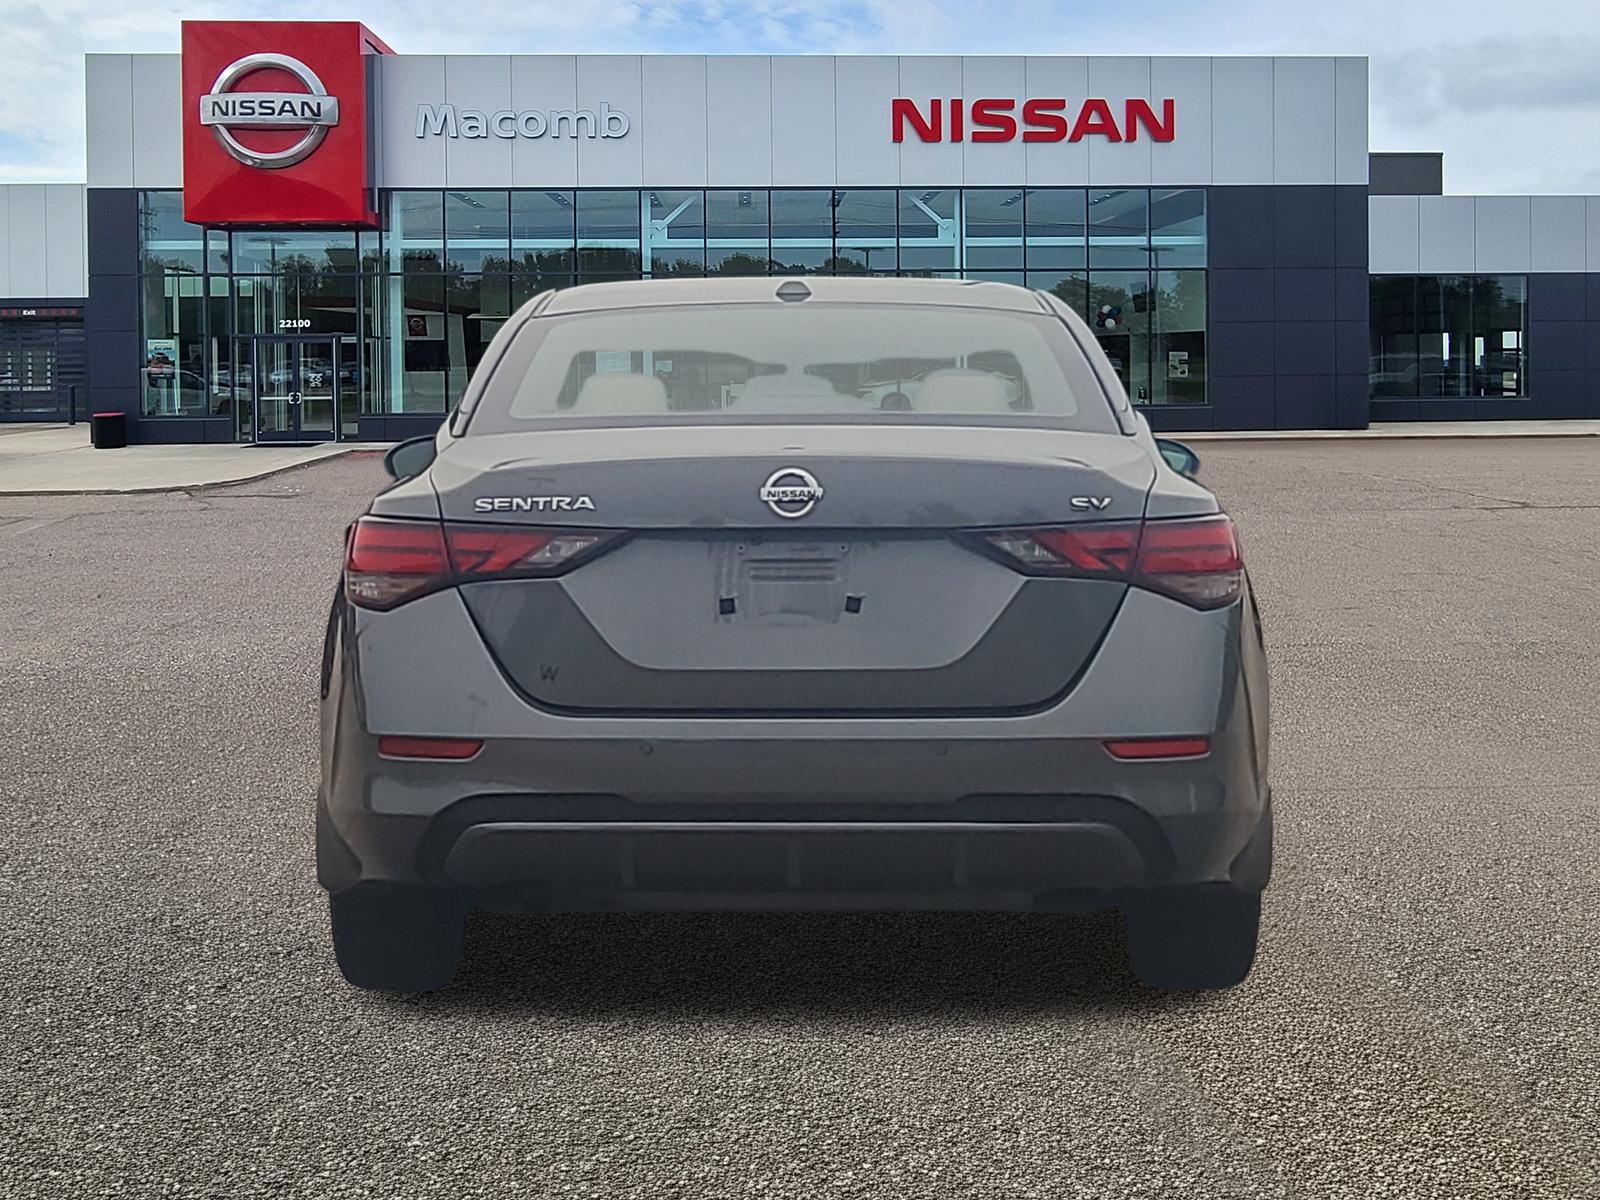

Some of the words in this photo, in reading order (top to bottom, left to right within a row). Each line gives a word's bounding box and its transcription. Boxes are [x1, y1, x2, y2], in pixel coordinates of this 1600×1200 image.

[212, 100, 321, 117] NISSAN
[415, 102, 630, 138] Macomb
[892, 98, 1175, 142] NISSAN
[279, 319, 311, 328] 22100
[767, 489, 816, 499] NISSAN
[474, 496, 596, 512] SENTRA
[1071, 497, 1111, 511] SV
